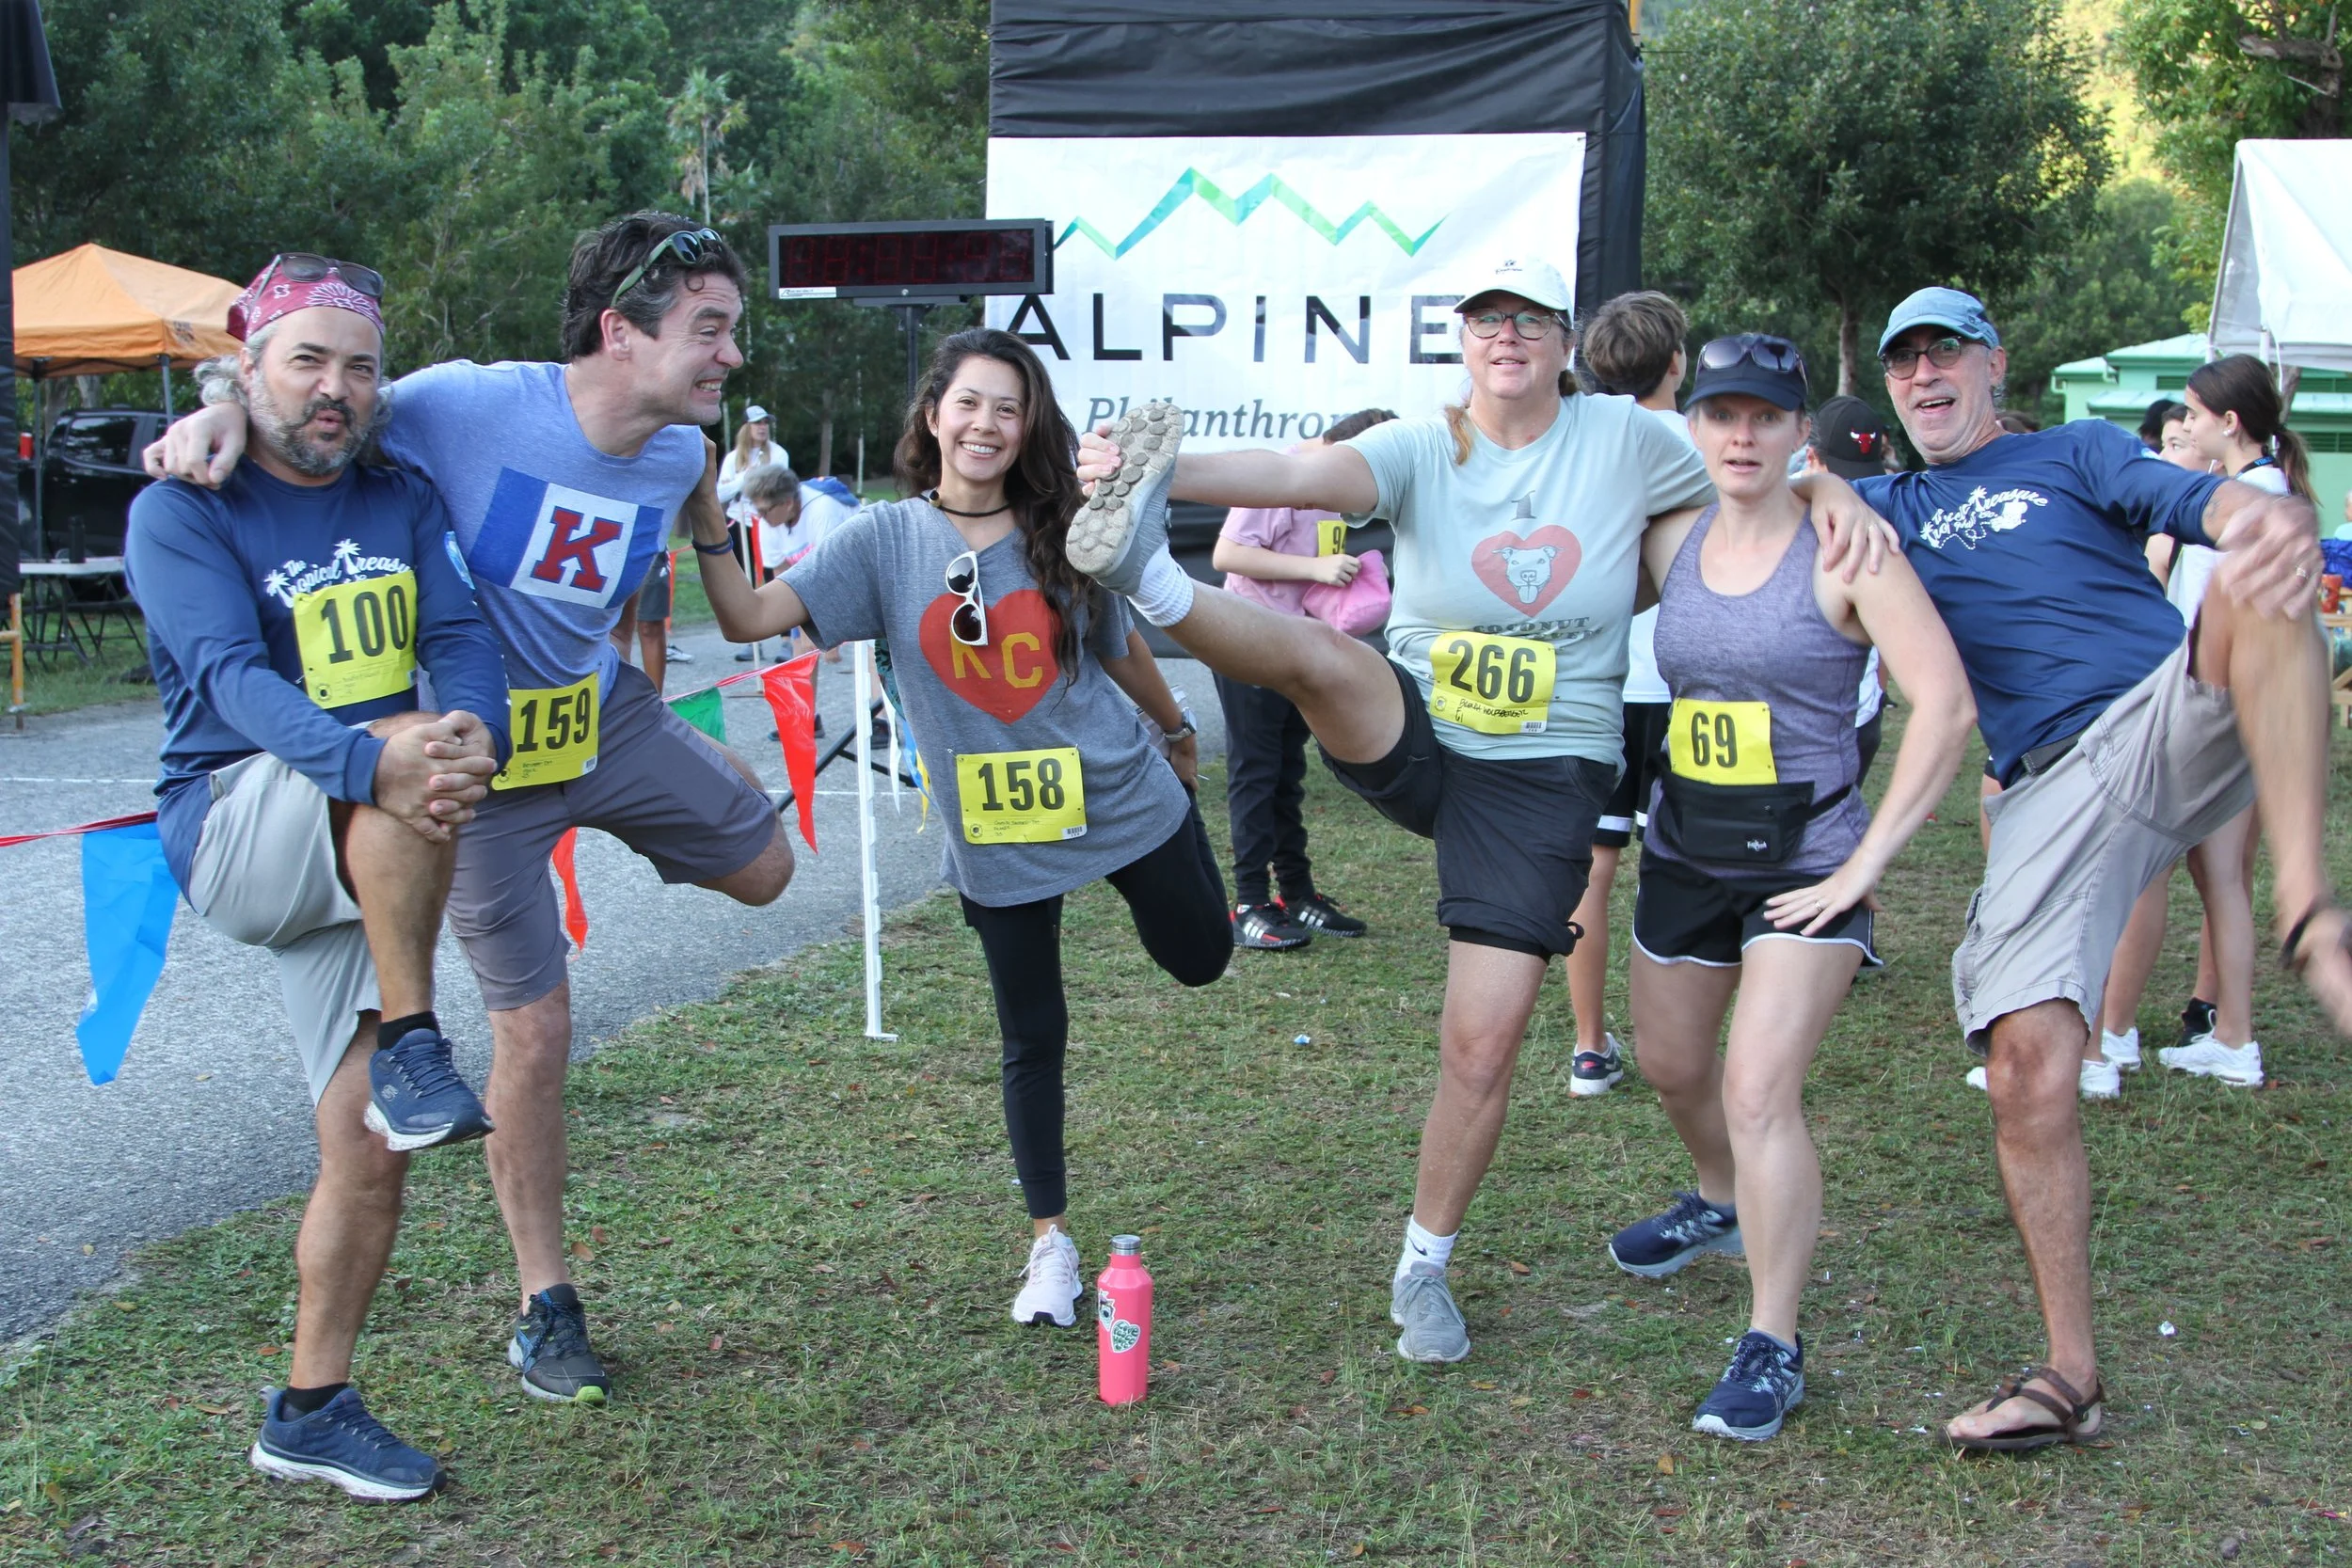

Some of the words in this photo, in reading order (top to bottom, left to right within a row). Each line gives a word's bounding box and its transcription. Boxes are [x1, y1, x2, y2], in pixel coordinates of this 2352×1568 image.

[1006, 293, 1466, 364] ALPINE
[1082, 396, 1352, 440] Panthro
[530, 505, 624, 594] K
[320, 584, 409, 665] 100
[1473, 616, 1590, 634] COCONUT
[949, 625, 1043, 689] KC
[1448, 639, 1537, 704] 266
[516, 688, 591, 753] 159
[1691, 711, 1739, 768] 69
[977, 757, 1065, 812] 158
